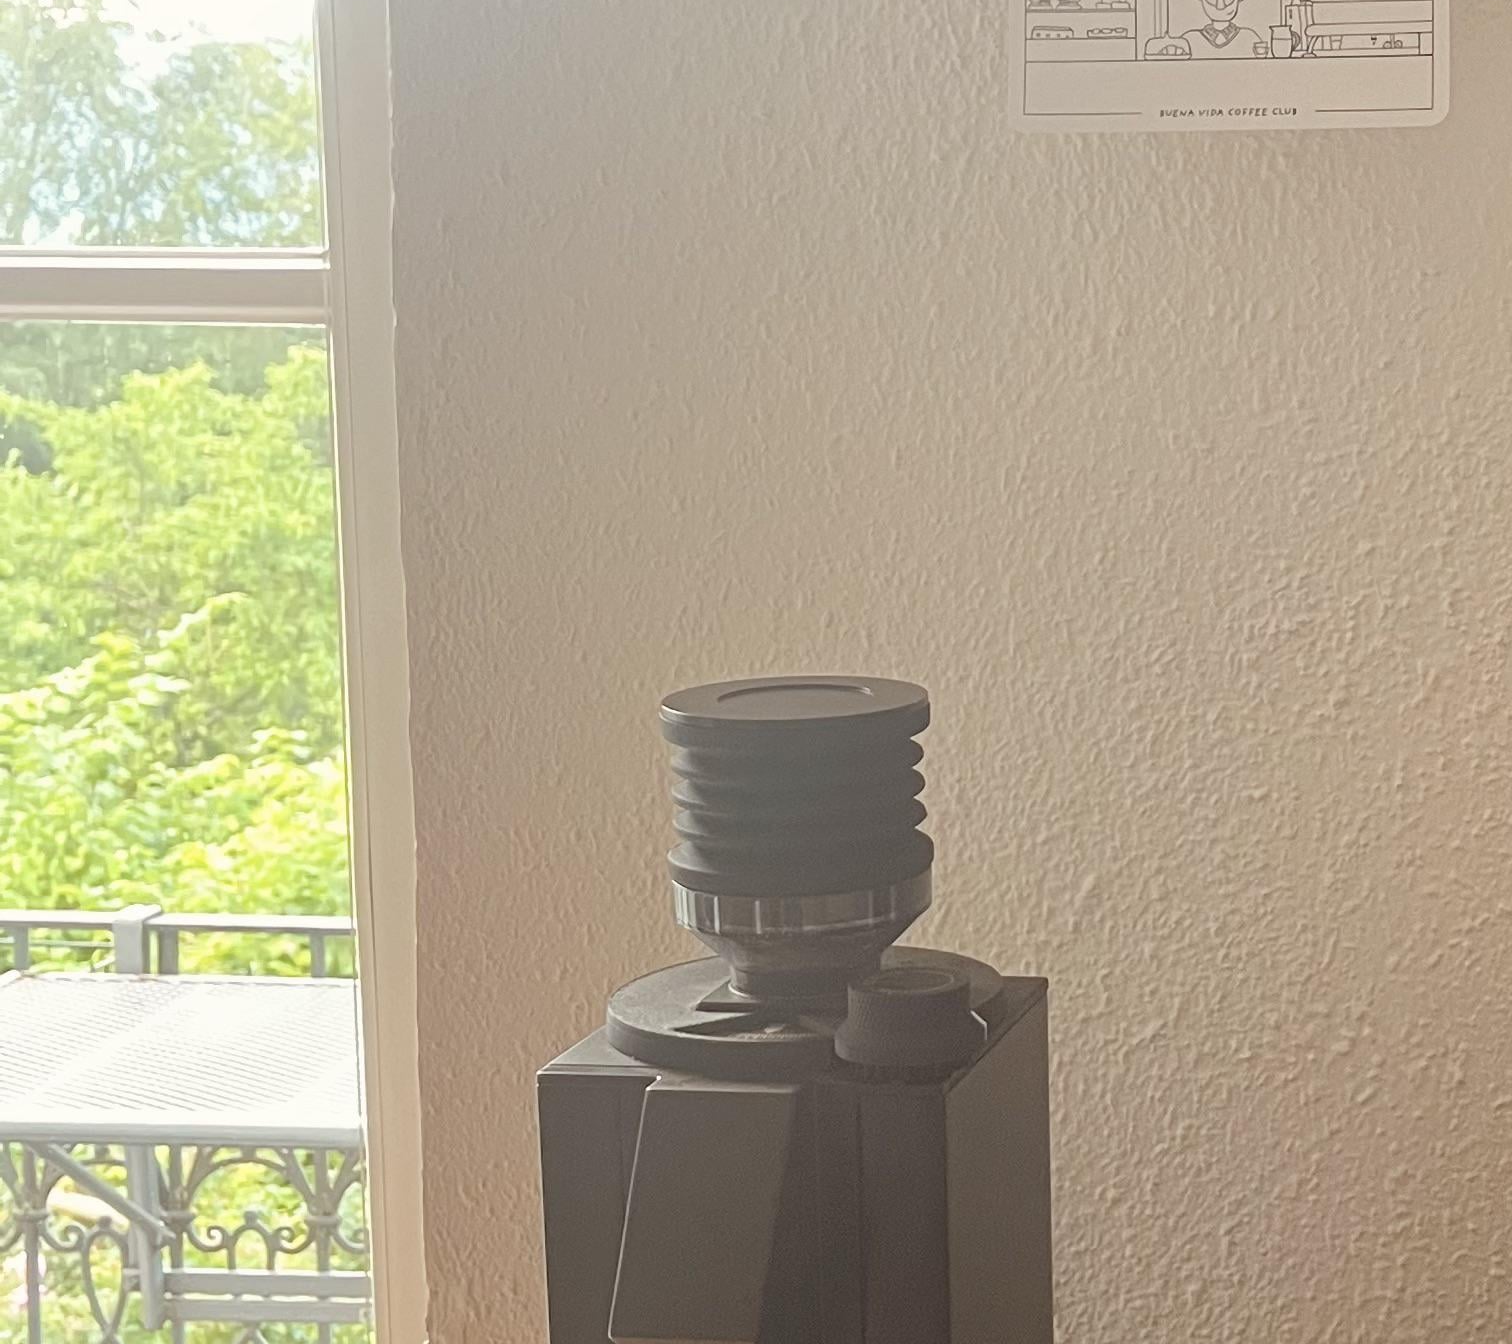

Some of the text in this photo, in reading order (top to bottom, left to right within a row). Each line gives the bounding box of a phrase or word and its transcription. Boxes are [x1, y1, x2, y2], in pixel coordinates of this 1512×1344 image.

[1159, 107, 1297, 118] BUENA VIDA COFFEE CLUB
